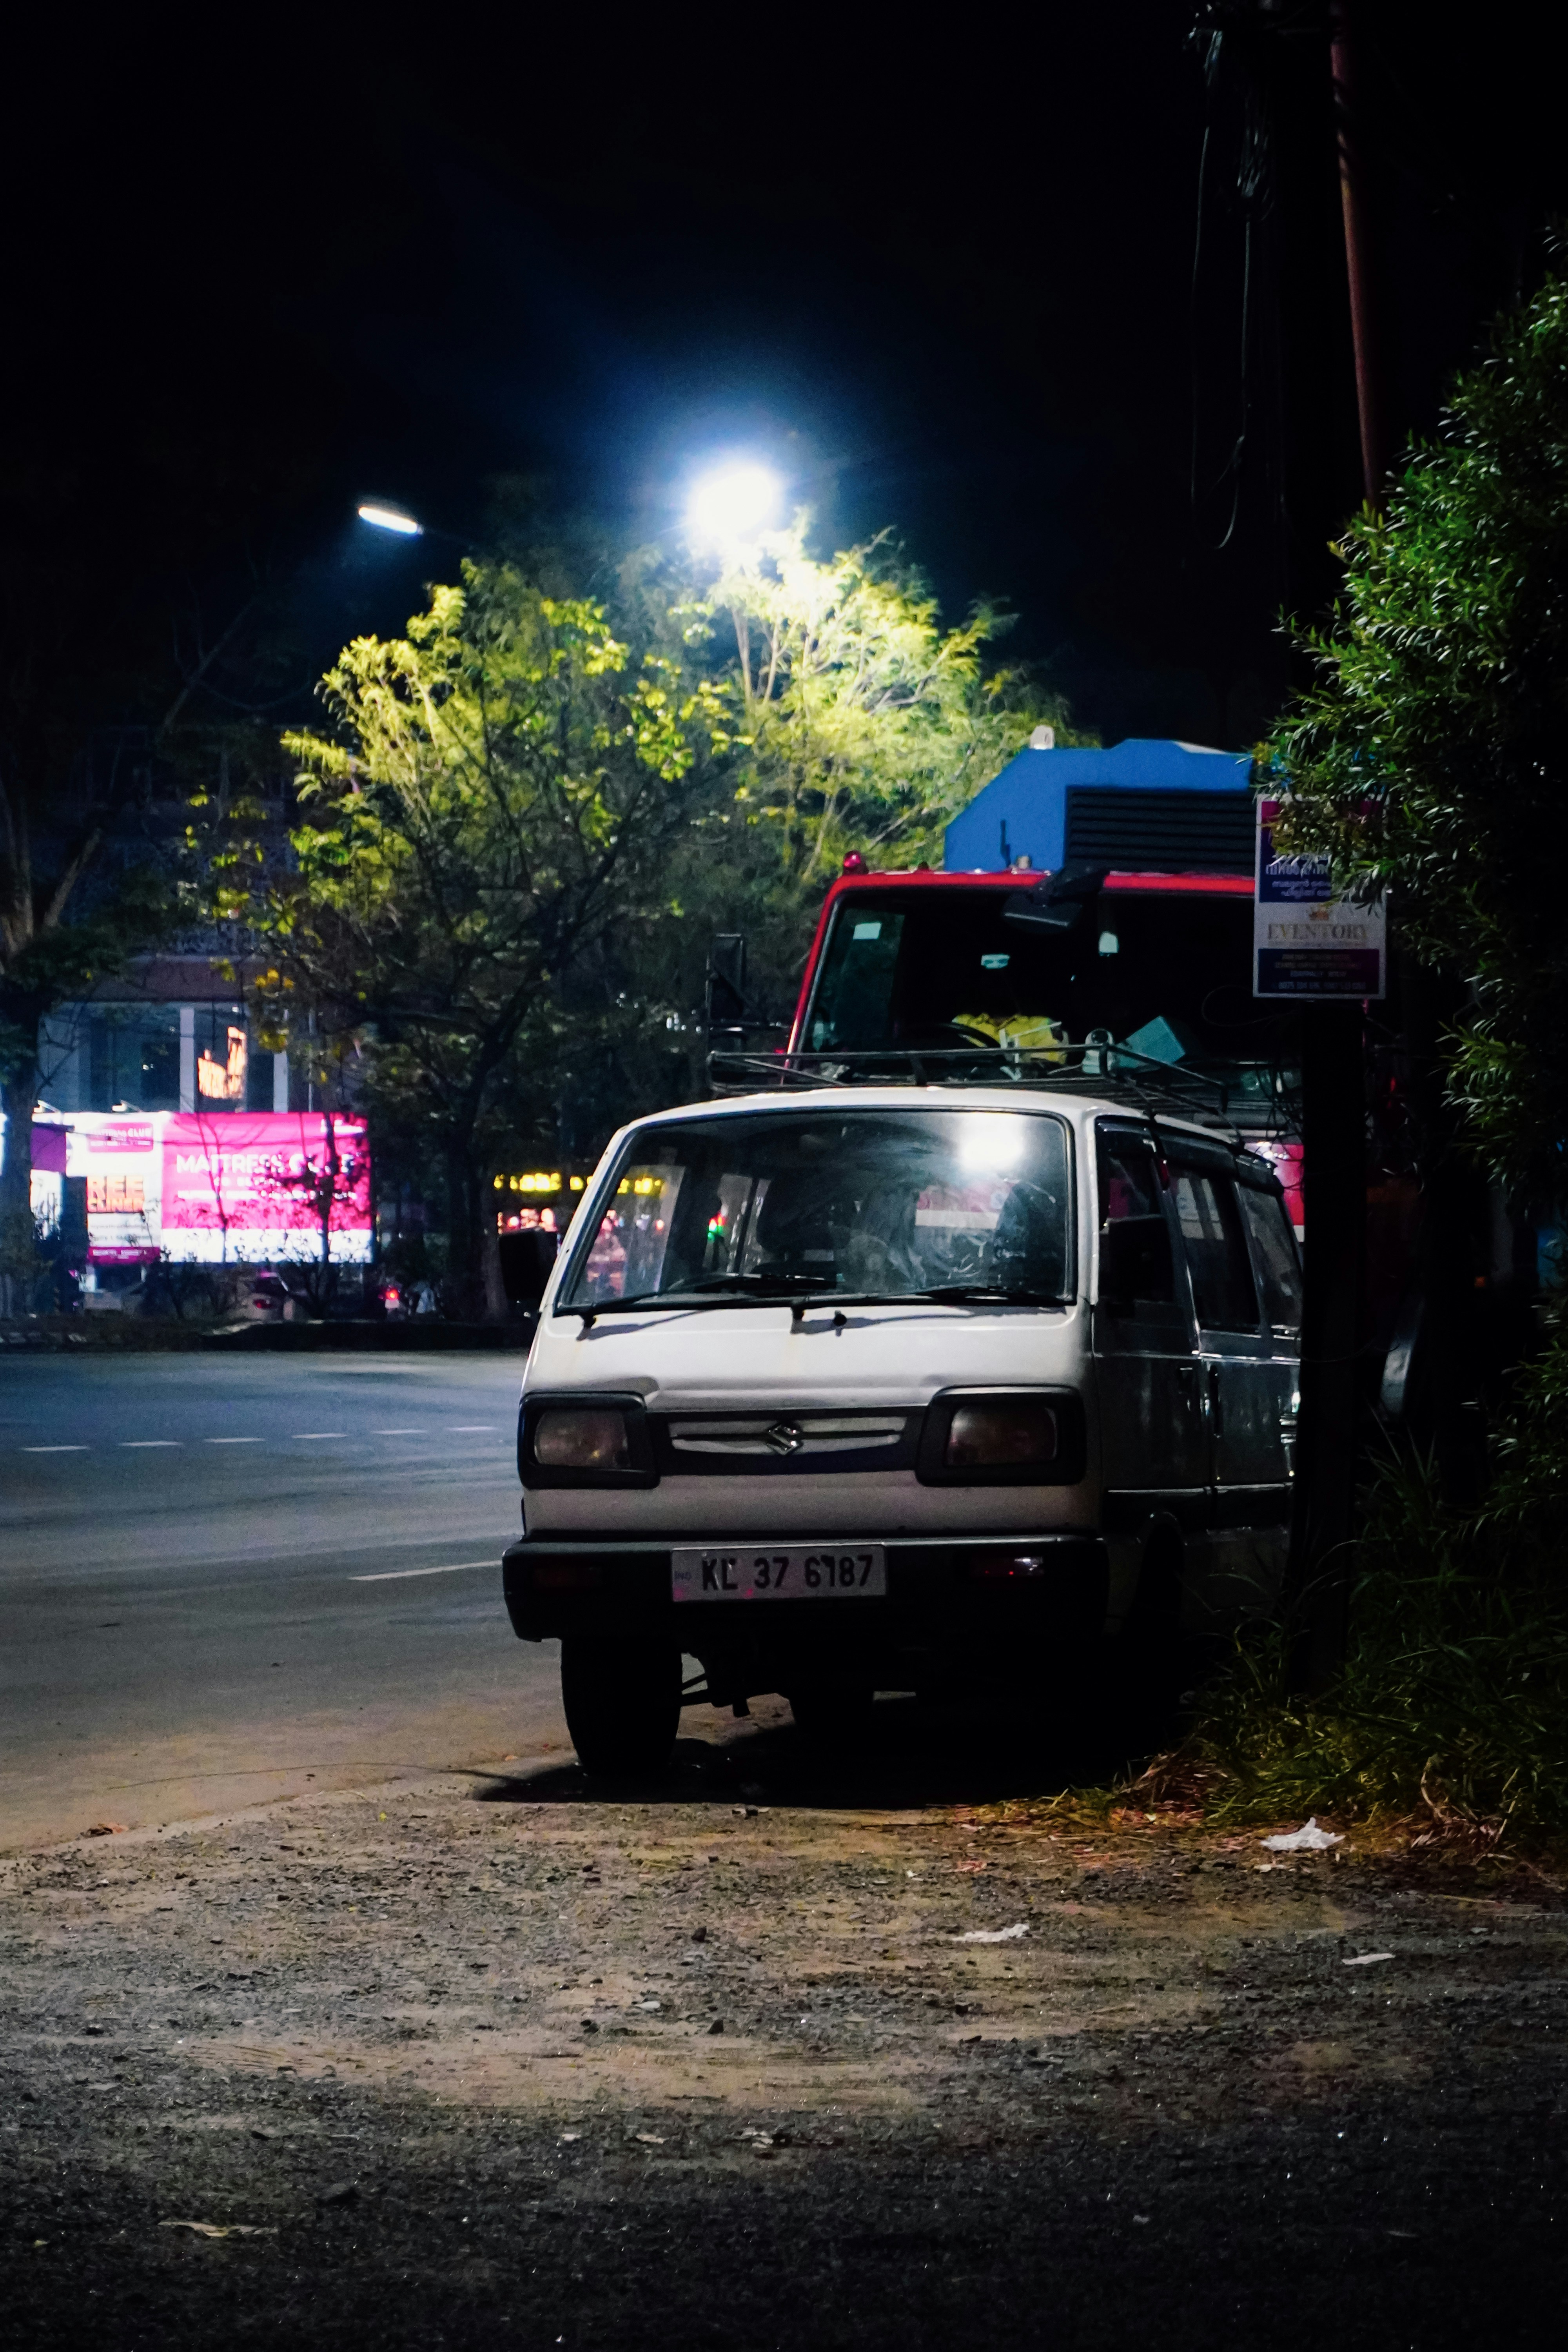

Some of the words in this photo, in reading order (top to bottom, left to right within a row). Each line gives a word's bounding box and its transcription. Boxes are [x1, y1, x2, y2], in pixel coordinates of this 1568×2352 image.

[176, 1154, 284, 1173] MATTRESS
[754, 1556, 789, 1589] 37
[805, 1554, 873, 1588] 6187
